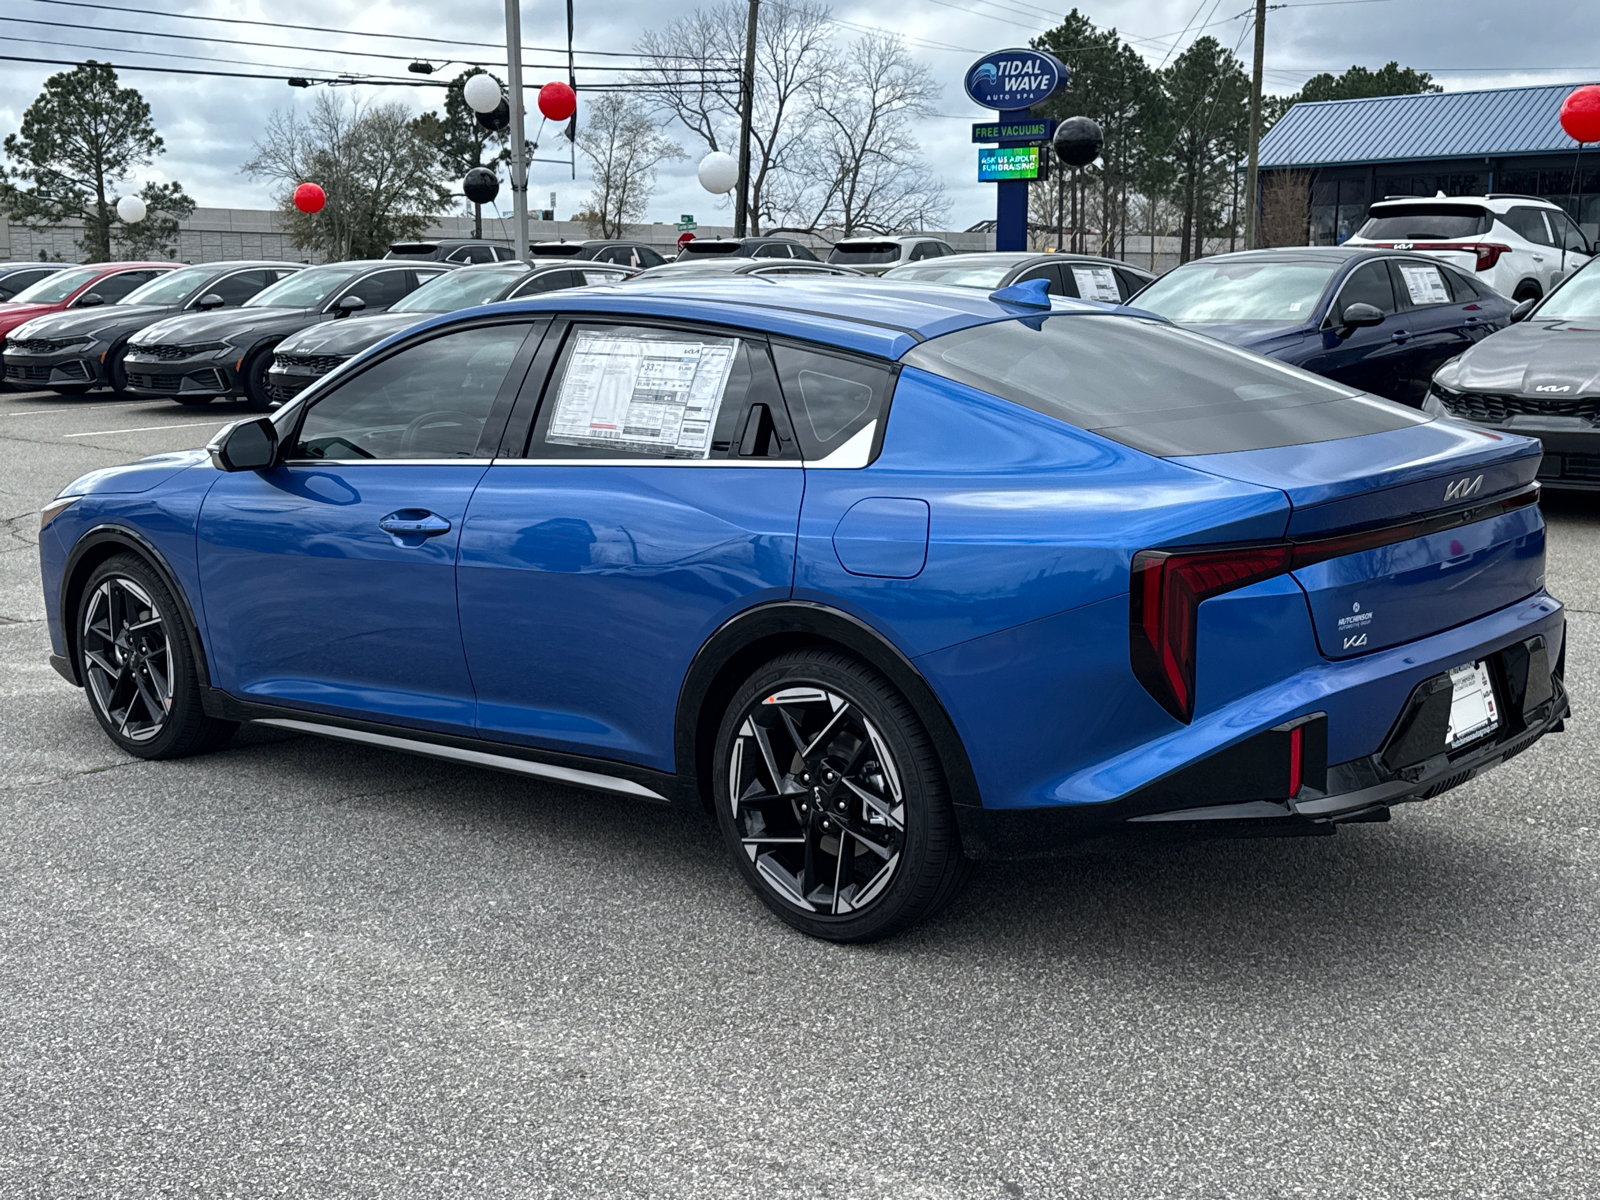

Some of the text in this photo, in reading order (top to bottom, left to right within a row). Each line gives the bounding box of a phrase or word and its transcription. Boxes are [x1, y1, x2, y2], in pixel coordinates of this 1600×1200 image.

[998, 59, 1041, 76] TIDAL
[1005, 75, 1051, 92] WAVE
[975, 124, 1045, 138] FREE VACUUMS
[981, 156, 996, 164] ASK
[982, 163, 1035, 172] FUNDRAISING
[645, 363, 655, 371] 33
[1535, 385, 1570, 393] KIA
[1443, 474, 1484, 502] KIA
[1338, 611, 1374, 627] HUTCHINSON
[1343, 633, 1367, 650] K4
